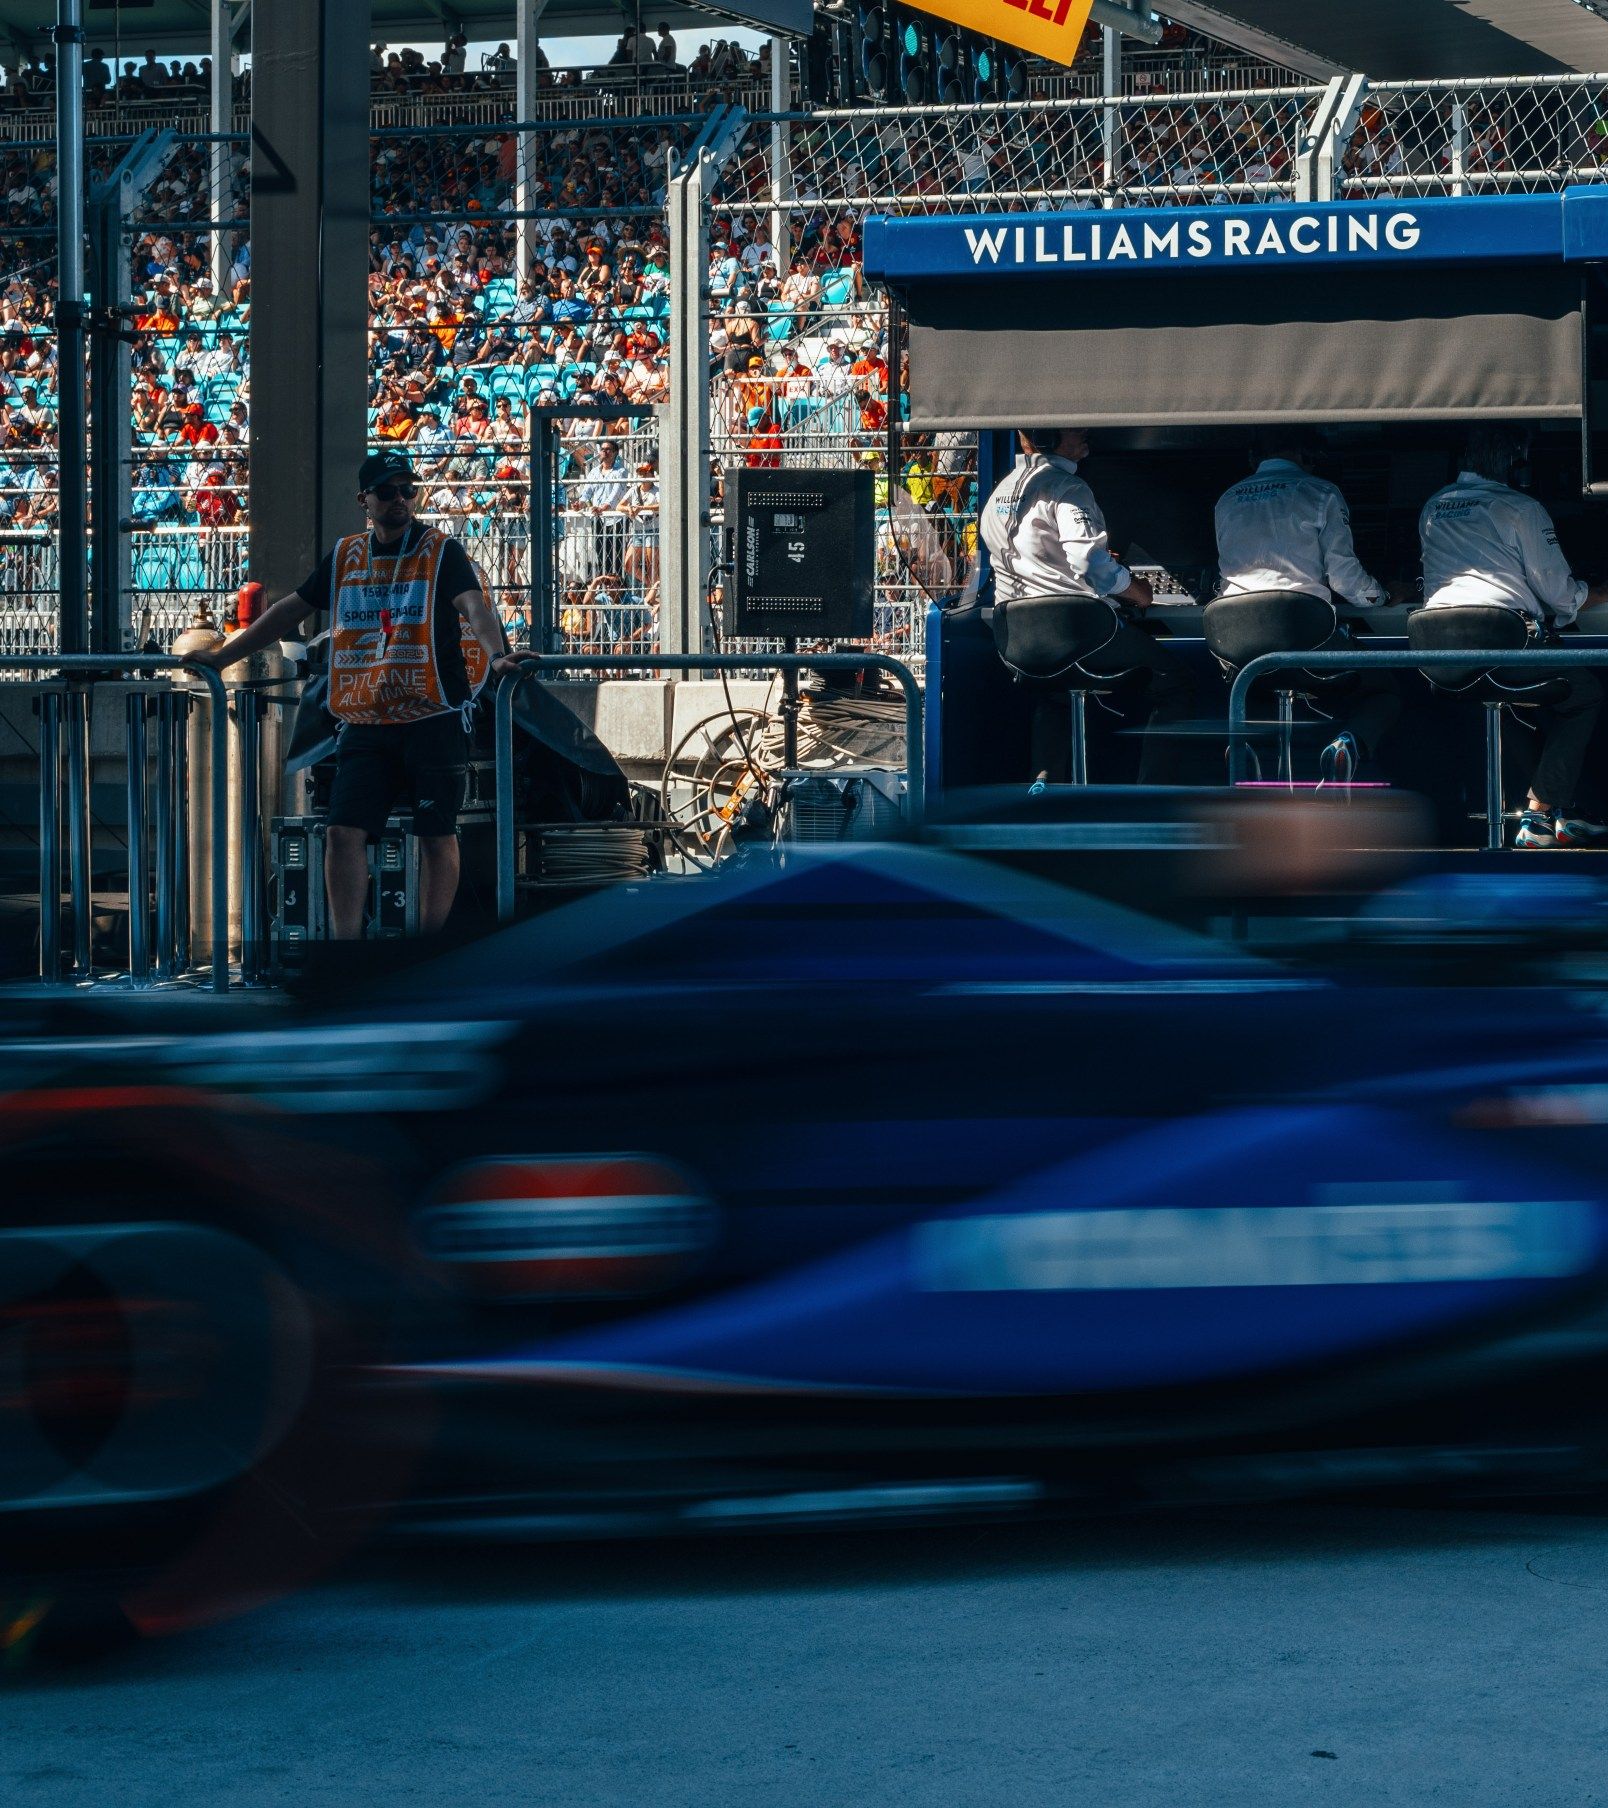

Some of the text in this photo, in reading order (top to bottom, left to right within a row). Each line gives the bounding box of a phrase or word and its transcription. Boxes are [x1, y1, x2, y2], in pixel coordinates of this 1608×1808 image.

[964, 212, 1421, 265] WILLIAMS RACING
[1235, 483, 1287, 496] WILLIAMS
[1435, 500, 1480, 511] WILLIAMS
[1435, 508, 1472, 520] RACING
[746, 526, 756, 577] CARLSON
[787, 541, 806, 563] 45
[344, 611, 380, 623] SPORT
[339, 691, 367, 707] ALL
